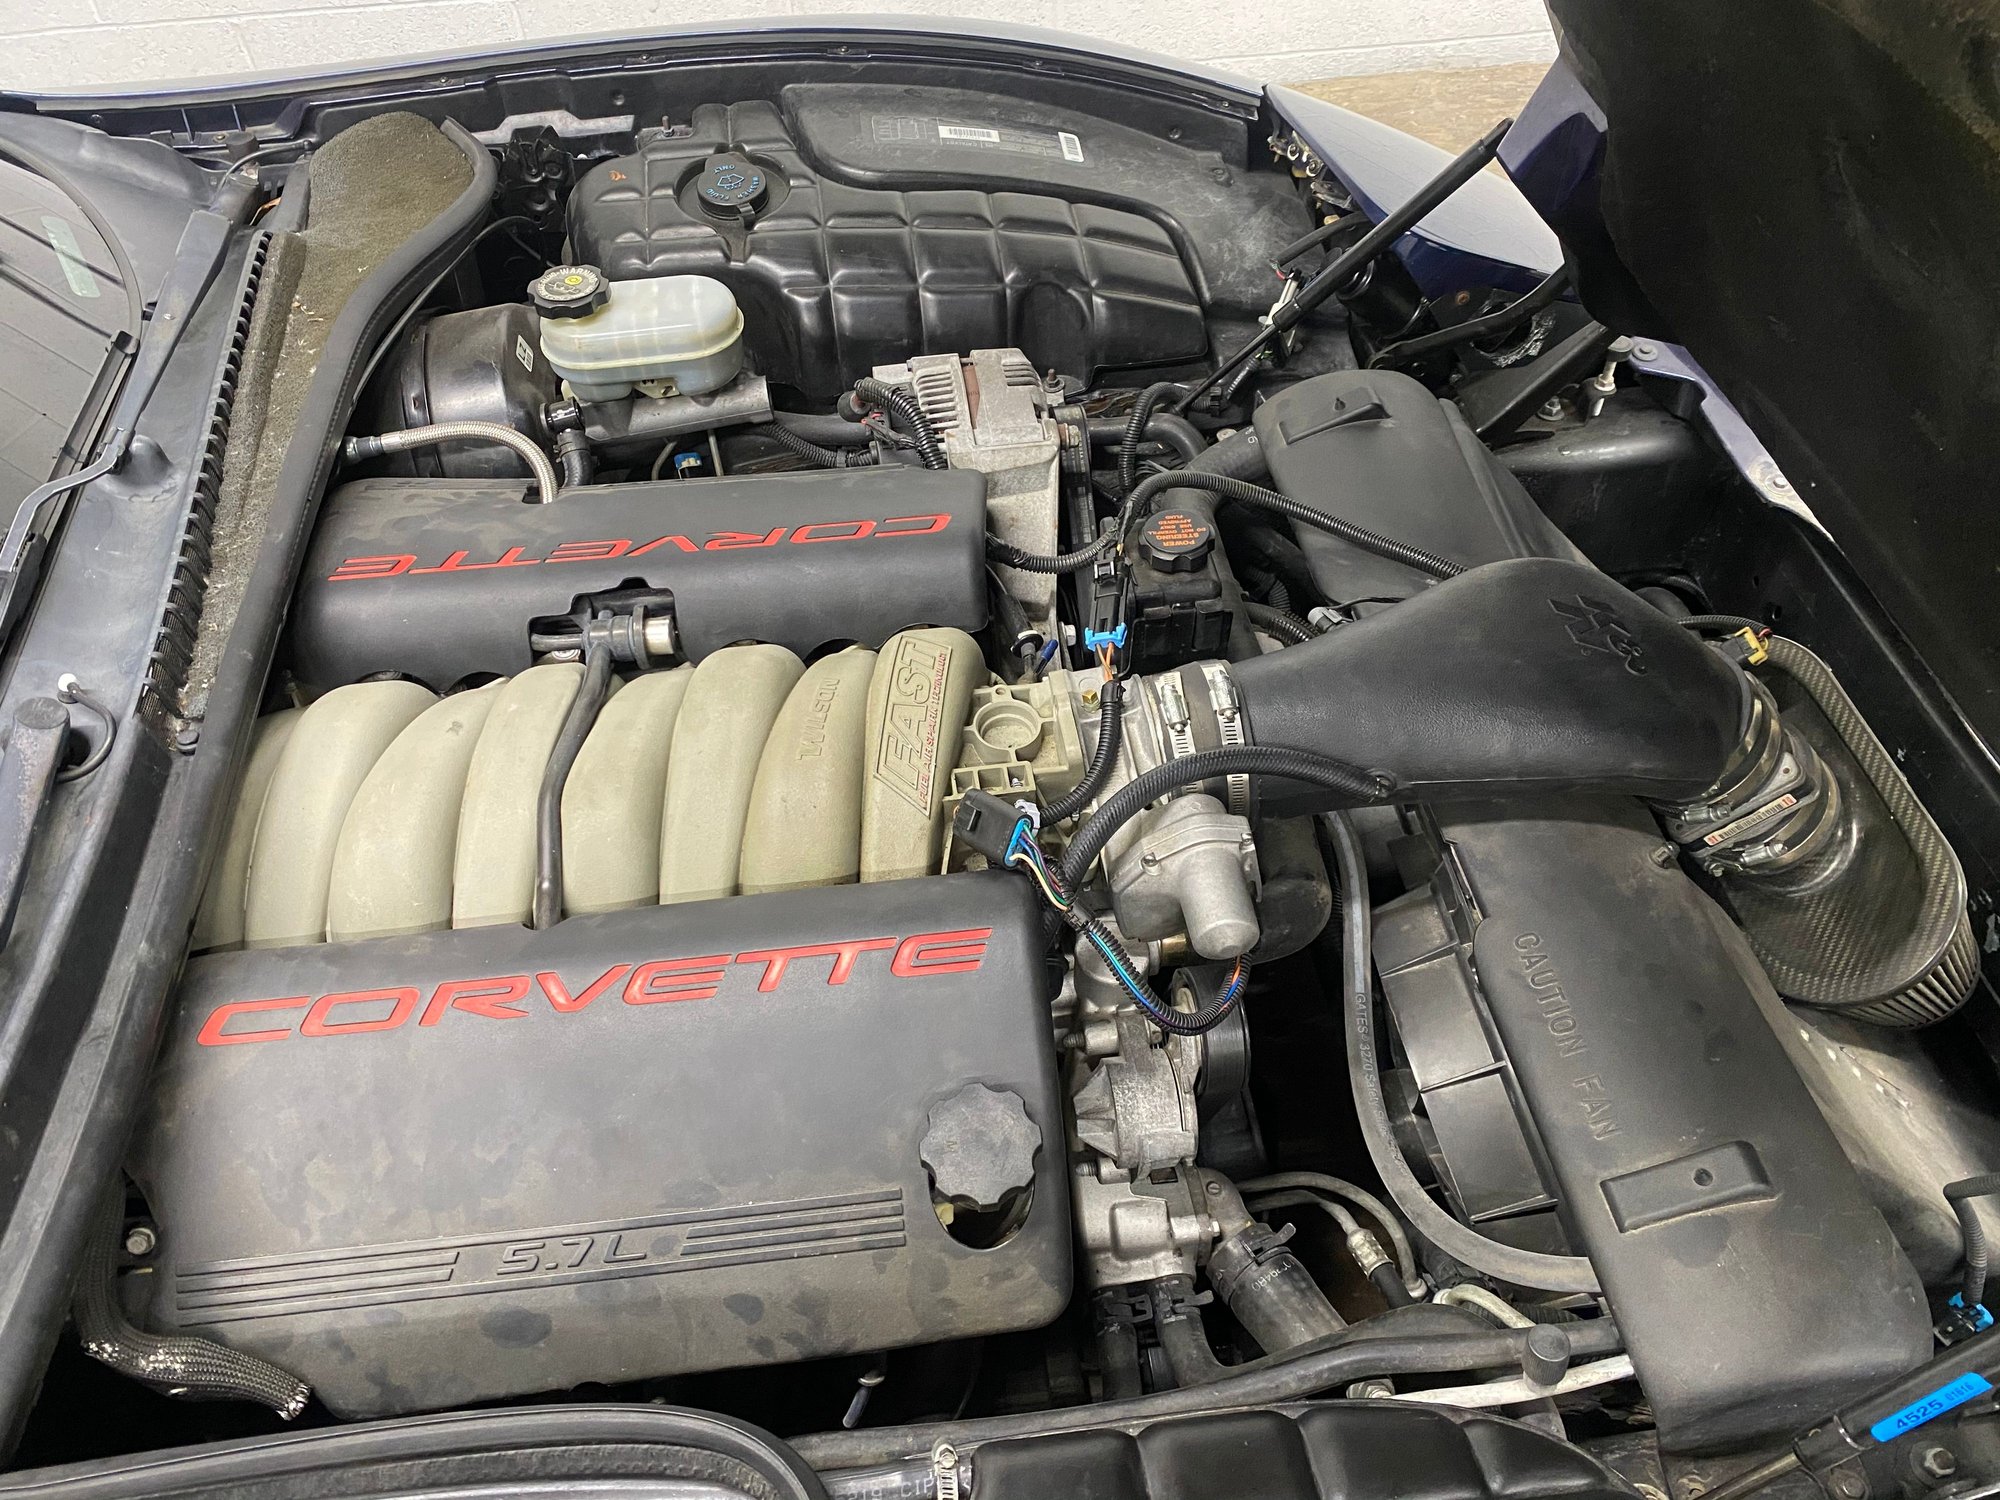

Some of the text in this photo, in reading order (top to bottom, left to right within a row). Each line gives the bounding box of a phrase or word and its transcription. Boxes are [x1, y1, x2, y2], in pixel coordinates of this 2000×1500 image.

[714, 164, 735, 174] ONLY
[706, 188, 730, 200] FLUID
[328, 513, 952, 581] CORVETTE
[1156, 532, 1199, 541] STEERING
[795, 677, 840, 761] WILSON
[883, 640, 937, 791] FAST
[927, 706, 938, 750] SPARK
[923, 747, 933, 771] AIR
[918, 772, 931, 807] FUEL
[195, 927, 994, 1047] CORVETTE
[1514, 932, 1623, 1141] CAUTION FAN
[1359, 1042, 1375, 1071] 3270
[1364, 1073, 1380, 1106] Safety
[497, 1234, 648, 1275] 5.7L
[1896, 1399, 1945, 1429] 4525
